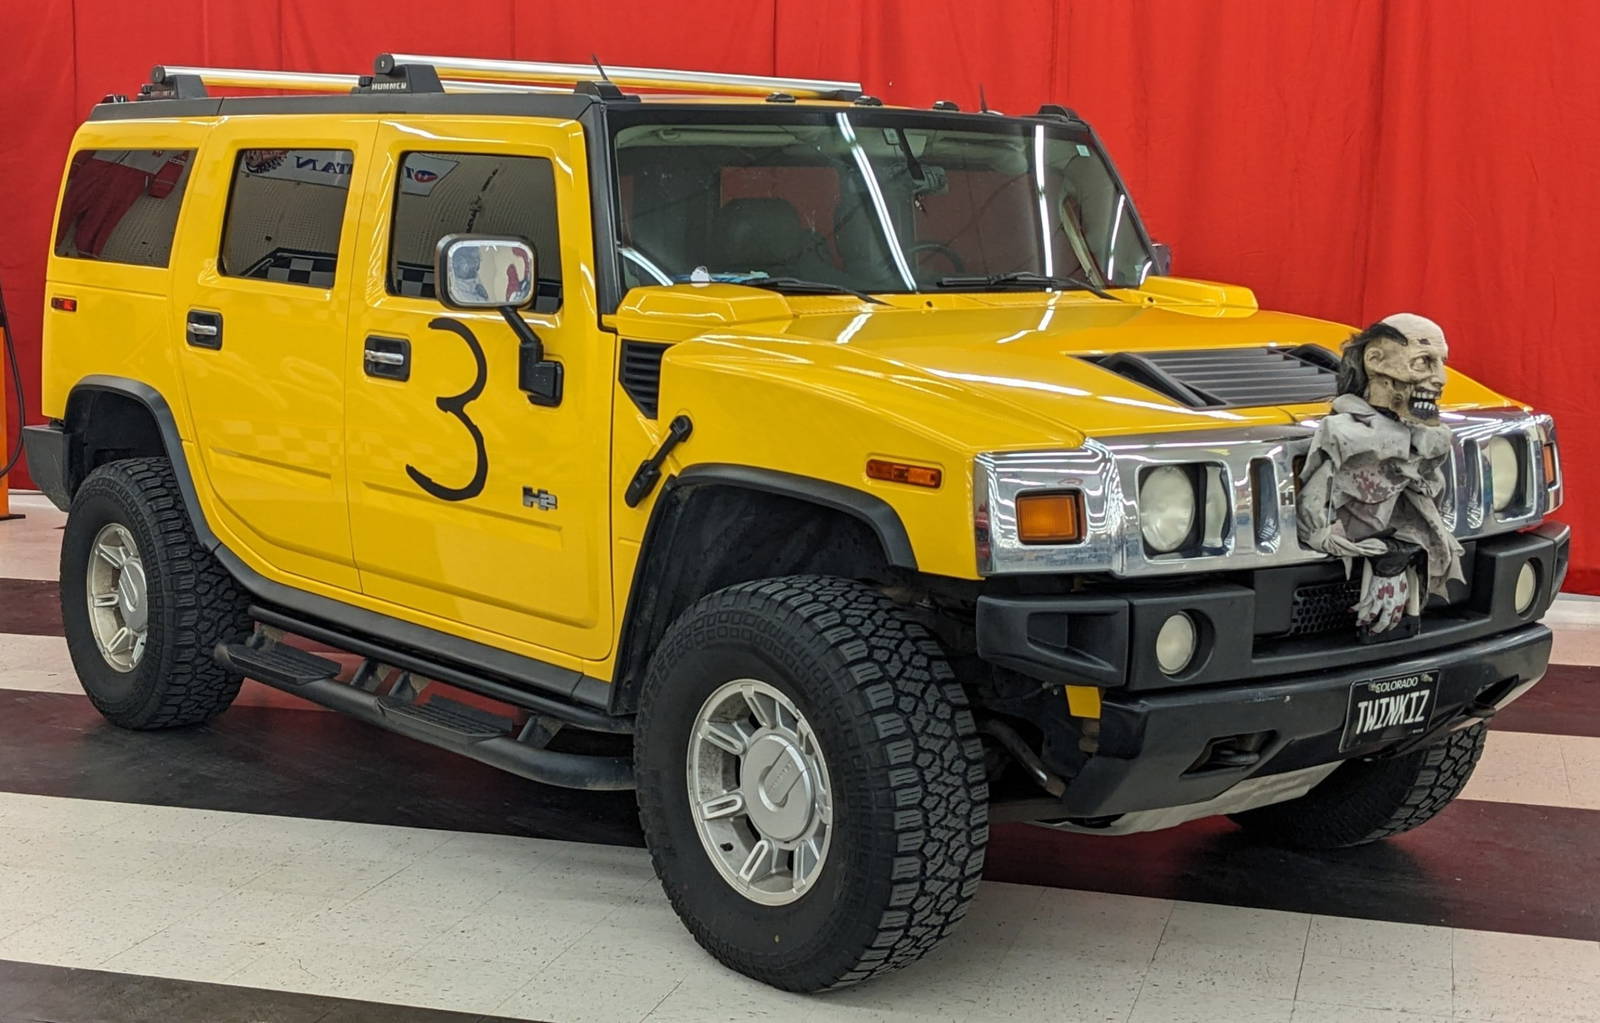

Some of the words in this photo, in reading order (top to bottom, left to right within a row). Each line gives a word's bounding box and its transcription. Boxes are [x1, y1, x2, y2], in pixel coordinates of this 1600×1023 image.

[405, 317, 489, 501] 3
[522, 486, 558, 511] H2
[1375, 677, 1419, 694] COLORADO
[1355, 689, 1430, 735] TWINKIZ
